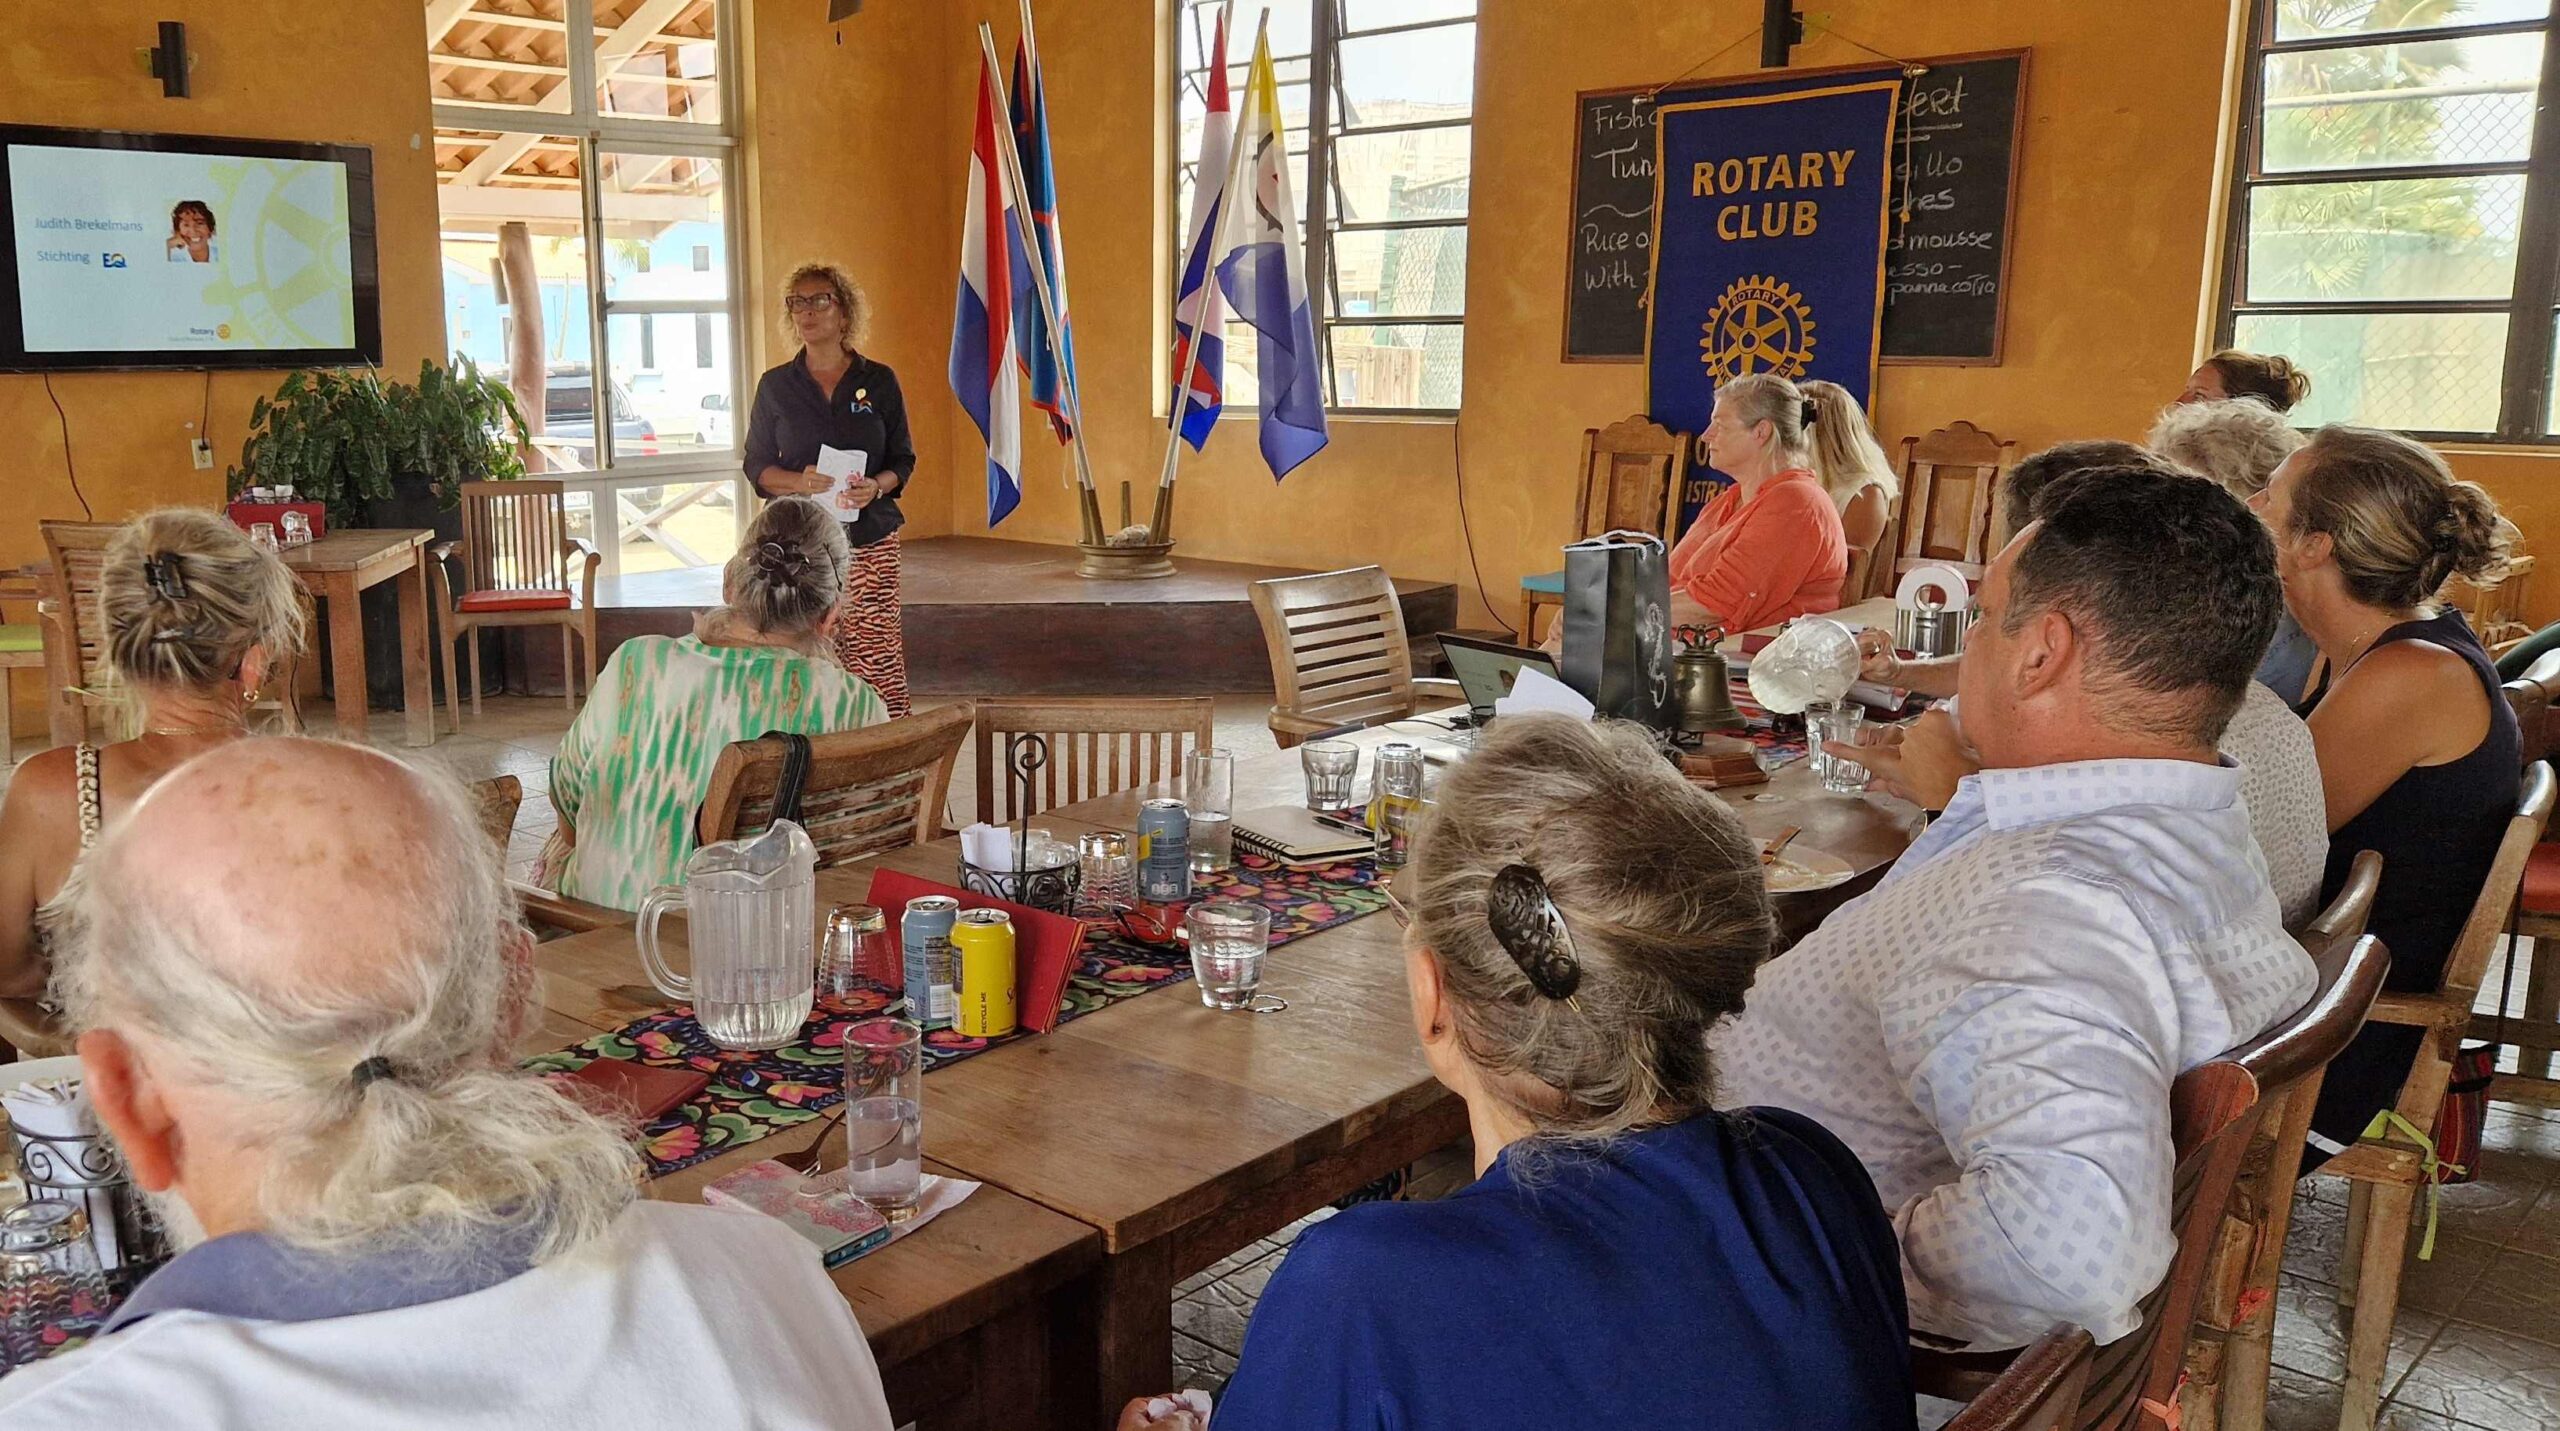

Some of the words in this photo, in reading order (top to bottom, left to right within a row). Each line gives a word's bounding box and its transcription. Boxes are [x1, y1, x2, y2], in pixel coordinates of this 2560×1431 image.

[1591, 104, 1644, 134] Fish
[1591, 138, 1657, 178] Tun
[1692, 149, 1855, 196] ROTARY
[35, 218, 72, 230] Judith
[74, 219, 144, 231] Brekelmans
[1717, 201, 1818, 241] CLUB
[37, 250, 90, 265] Stichting
[1731, 289, 1781, 307] ROTARY
